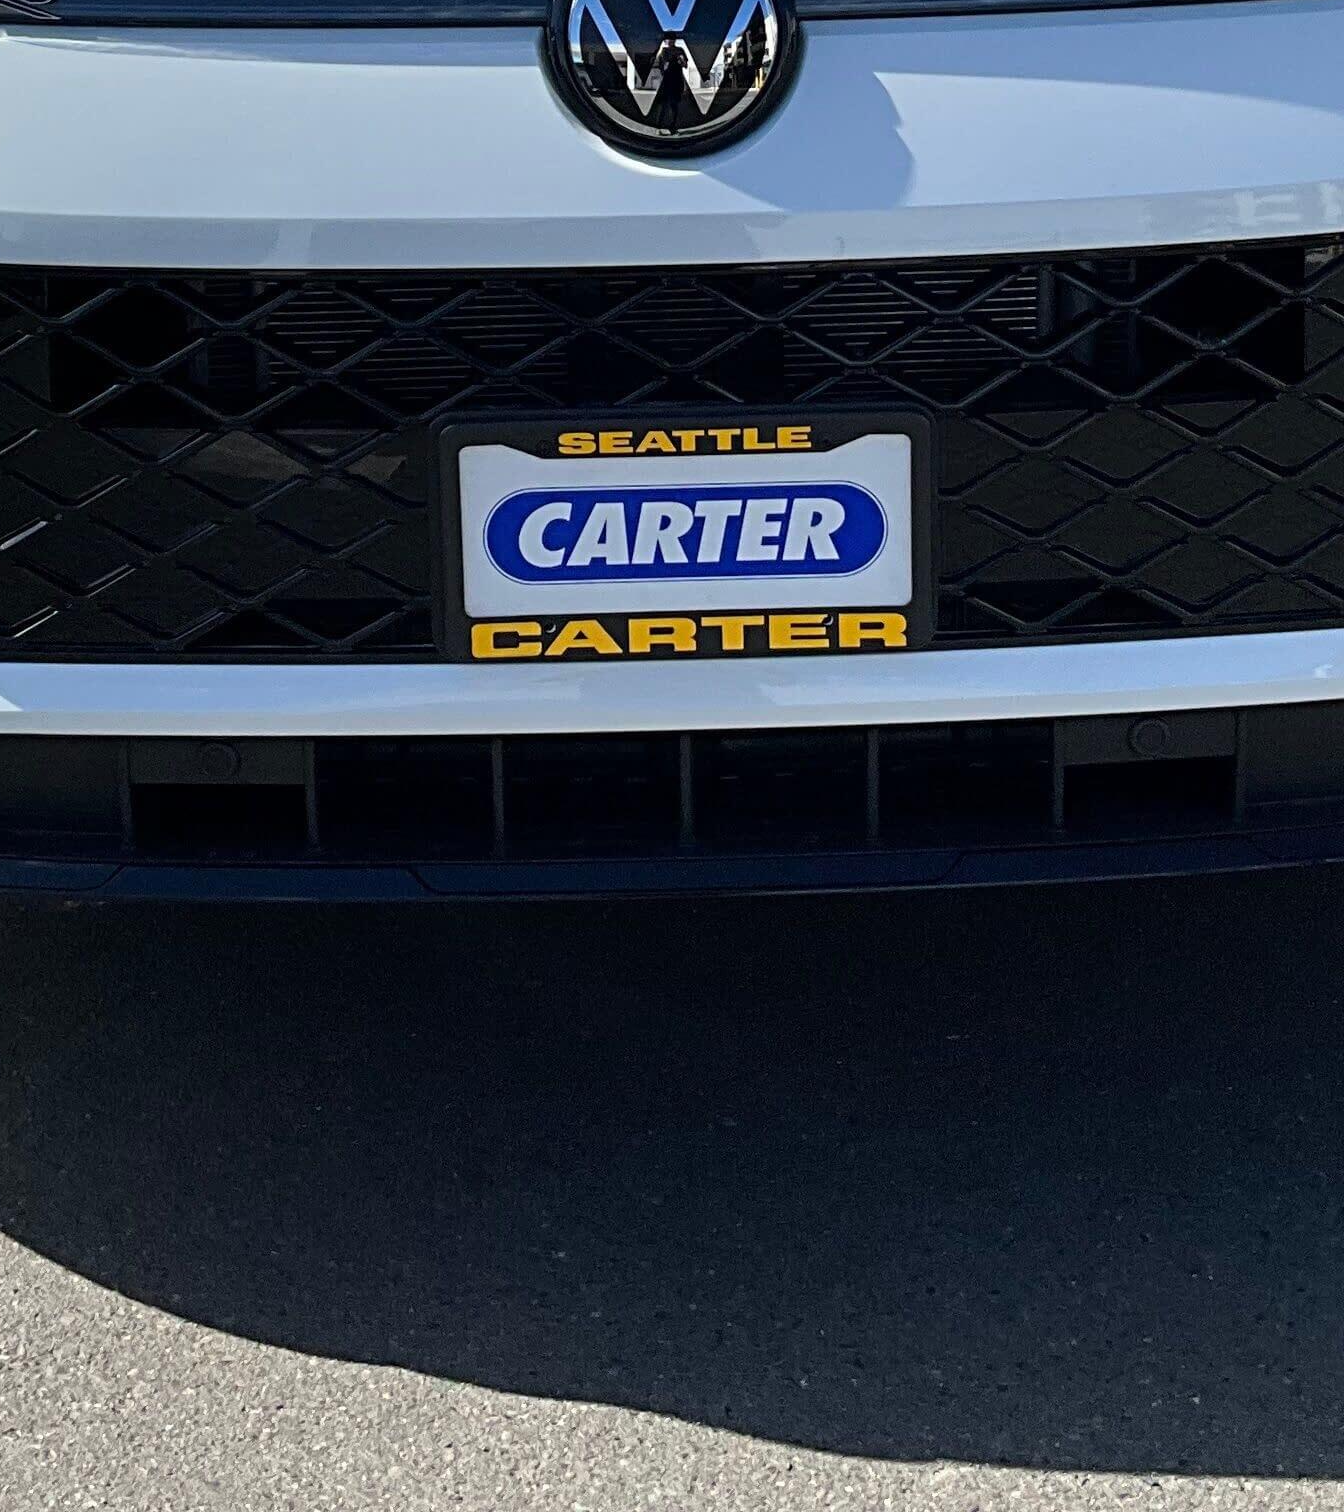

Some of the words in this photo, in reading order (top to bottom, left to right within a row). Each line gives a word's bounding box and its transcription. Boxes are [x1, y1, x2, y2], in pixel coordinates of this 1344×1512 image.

[558, 425, 812, 455] SEATTLE
[518, 497, 846, 569] CARTER
[471, 611, 908, 659] CARTER
